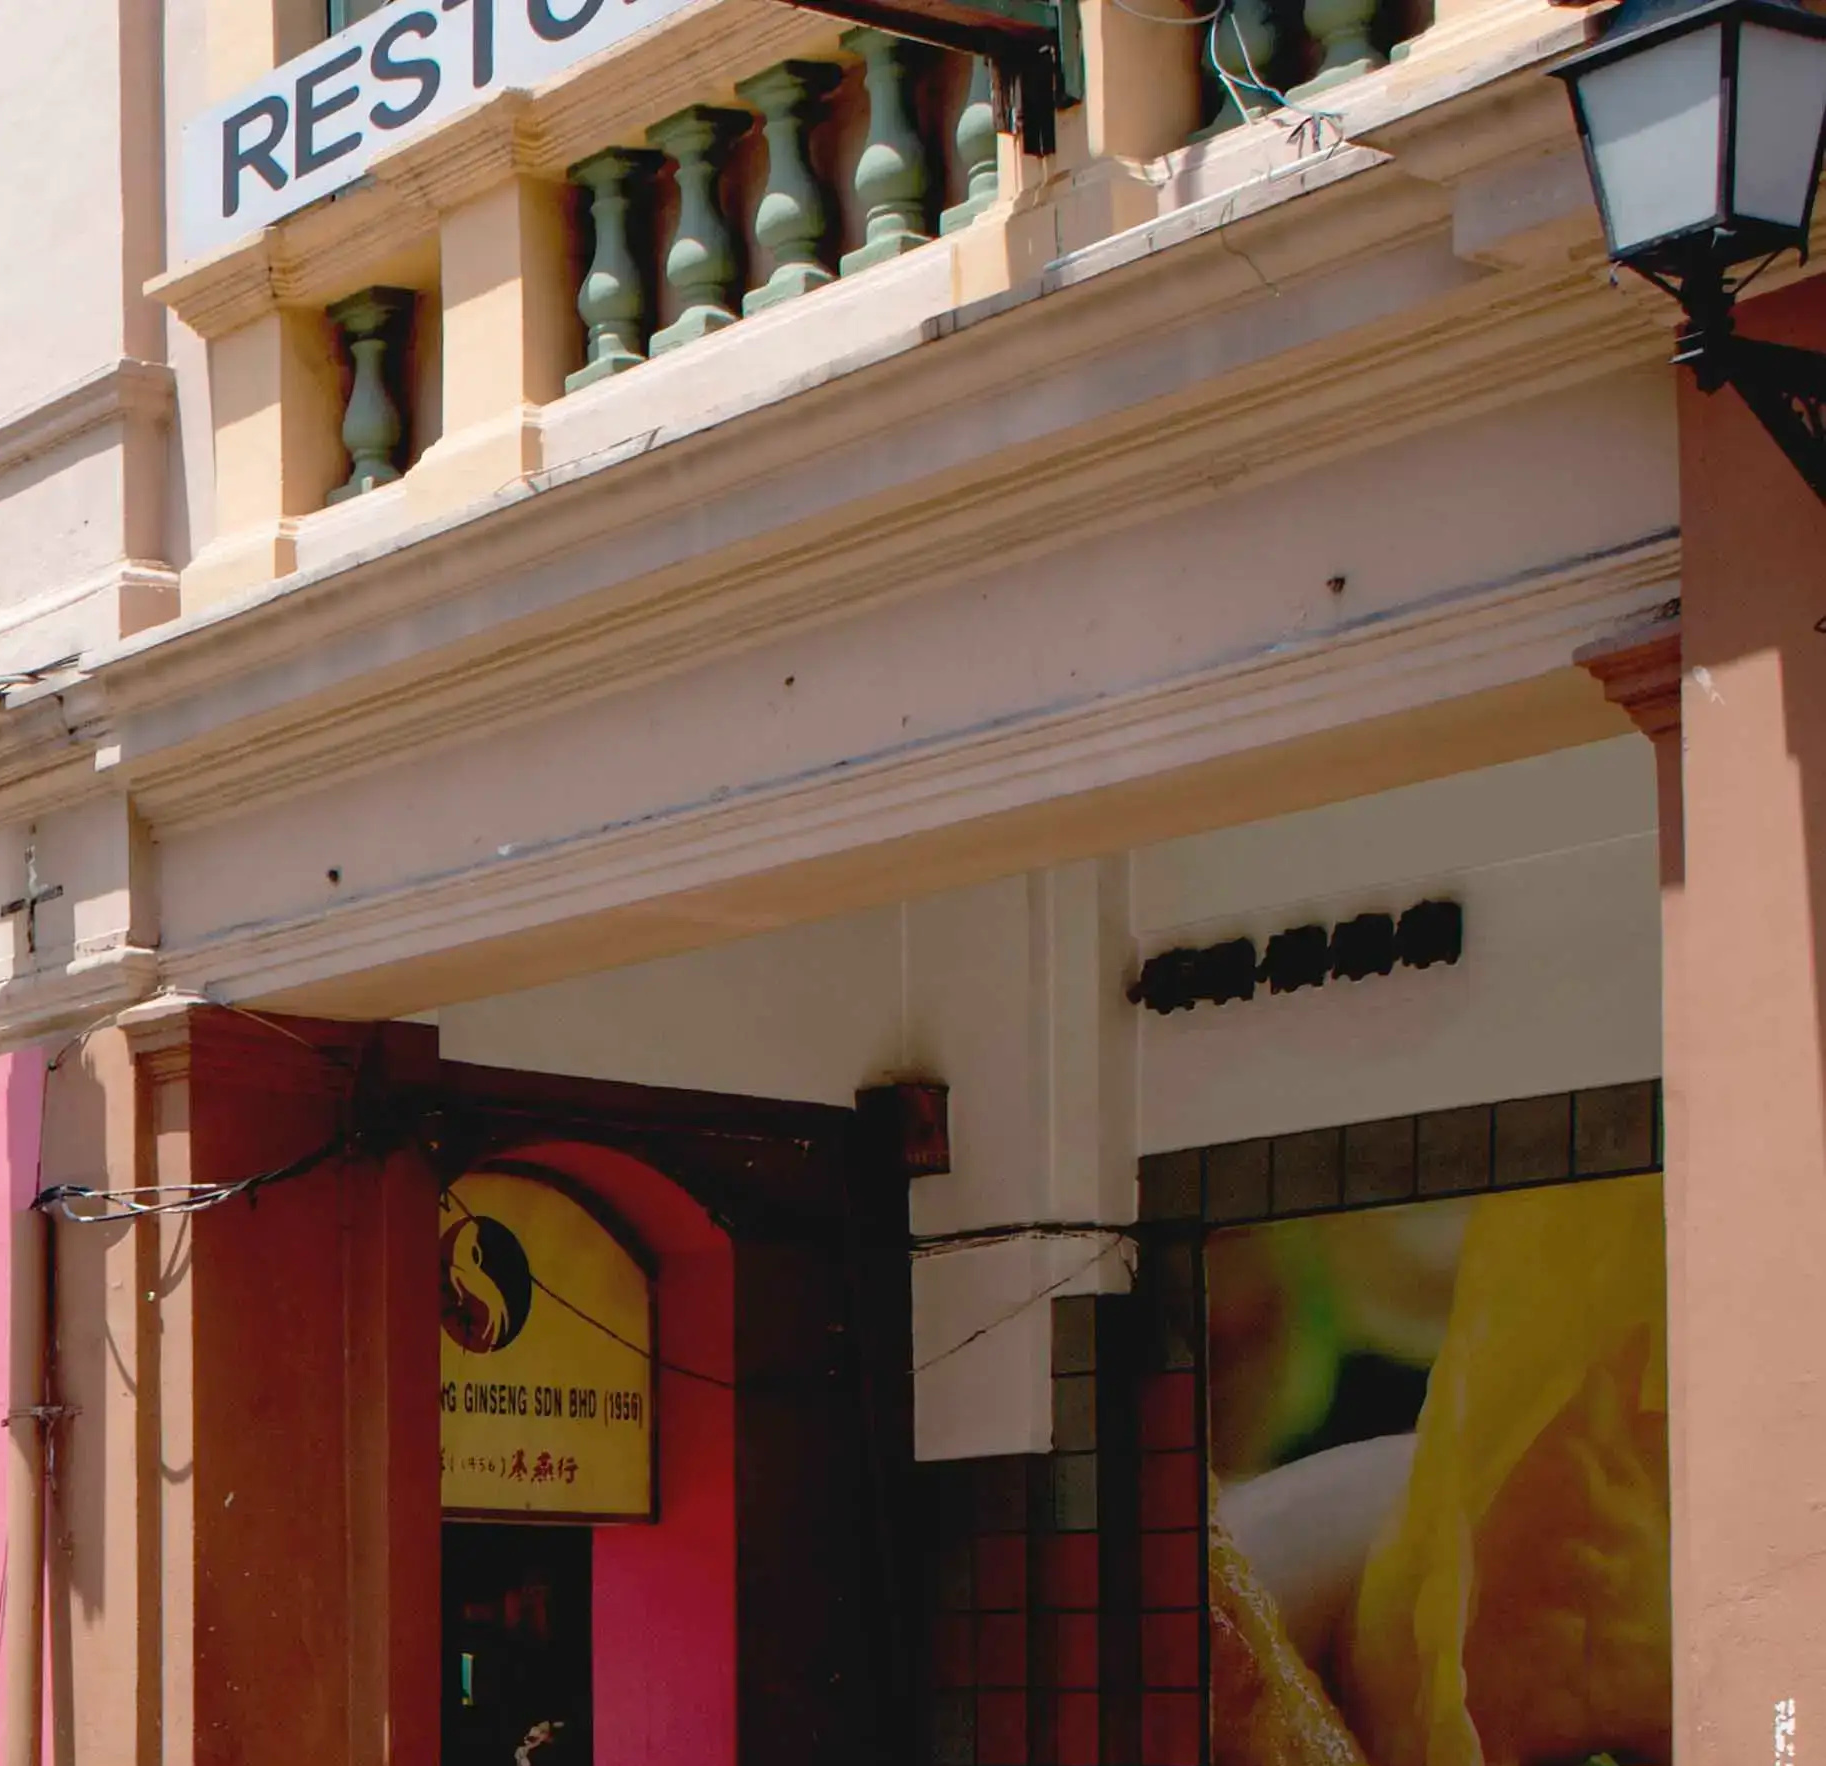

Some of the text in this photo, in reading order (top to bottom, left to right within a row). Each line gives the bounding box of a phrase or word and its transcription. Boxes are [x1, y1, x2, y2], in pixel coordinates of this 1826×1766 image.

[464, 1382, 528, 1416] GINSENG
[534, 1385, 562, 1417] SDN
[569, 1387, 597, 1419] BHD
